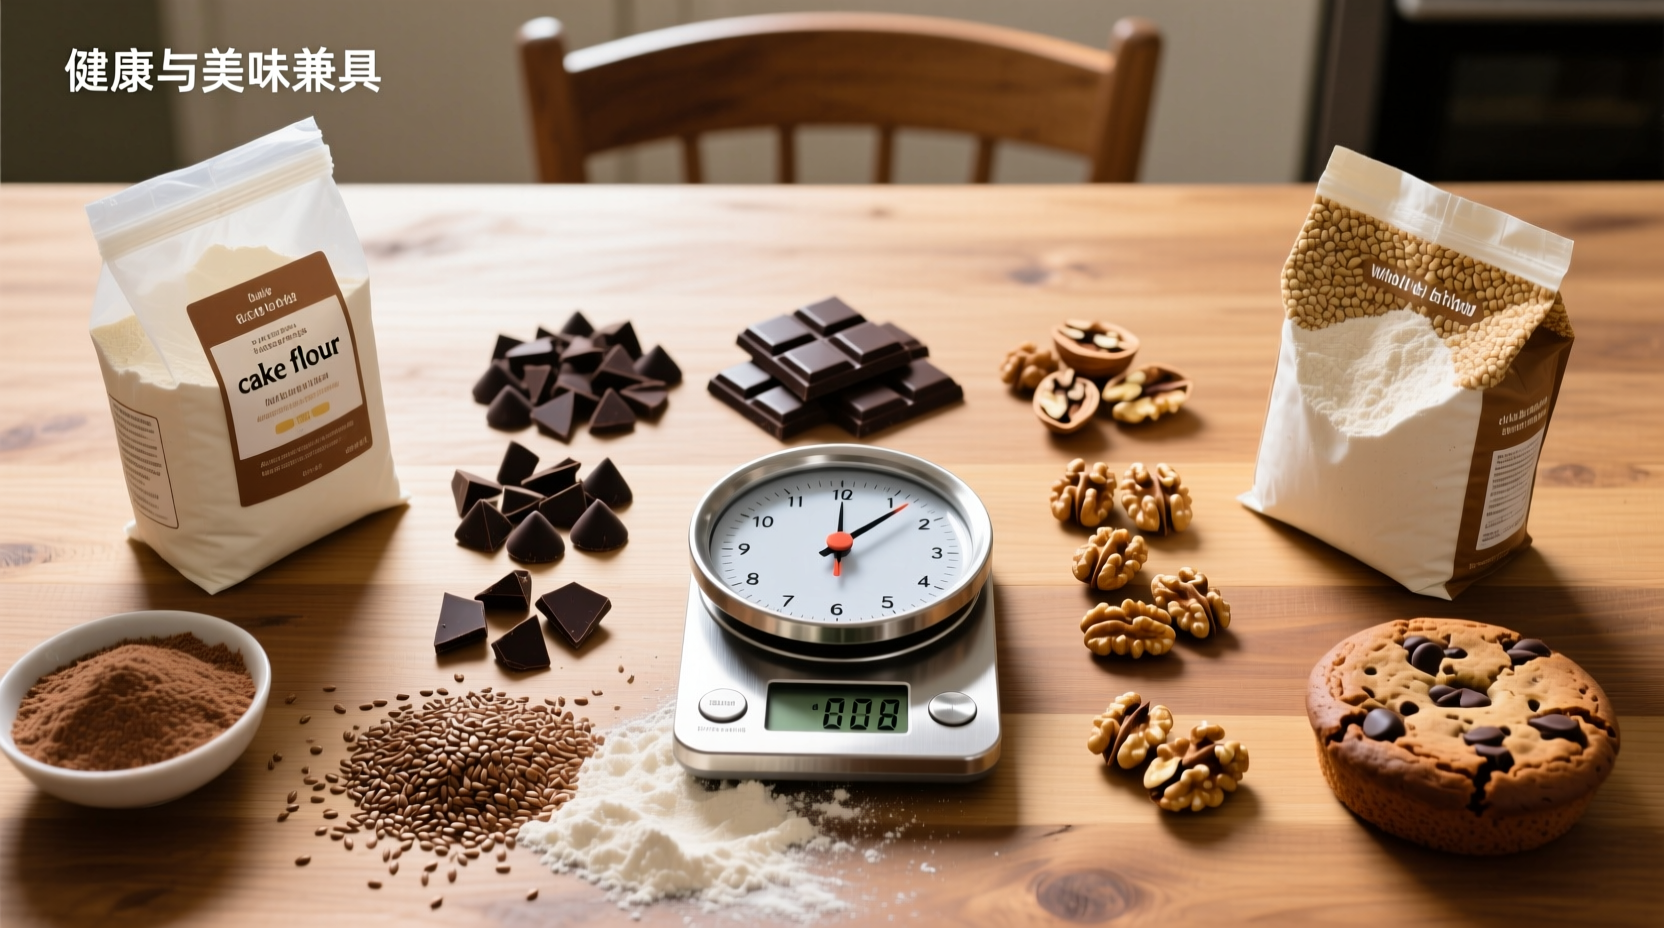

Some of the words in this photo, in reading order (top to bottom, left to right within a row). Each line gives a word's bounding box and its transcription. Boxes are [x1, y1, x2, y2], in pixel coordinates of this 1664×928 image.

[238, 362, 287, 394] cake
[289, 336, 340, 374] flour
[788, 496, 803, 507] 11
[888, 497, 893, 509] 1
[752, 515, 774, 528] 10
[918, 518, 931, 530] 2
[738, 543, 750, 556] 9
[931, 547, 943, 559] 3
[746, 572, 760, 586] 8
[917, 575, 931, 588] 4
[782, 595, 795, 608] 7
[881, 596, 894, 609] 5
[830, 603, 844, 616] 6
